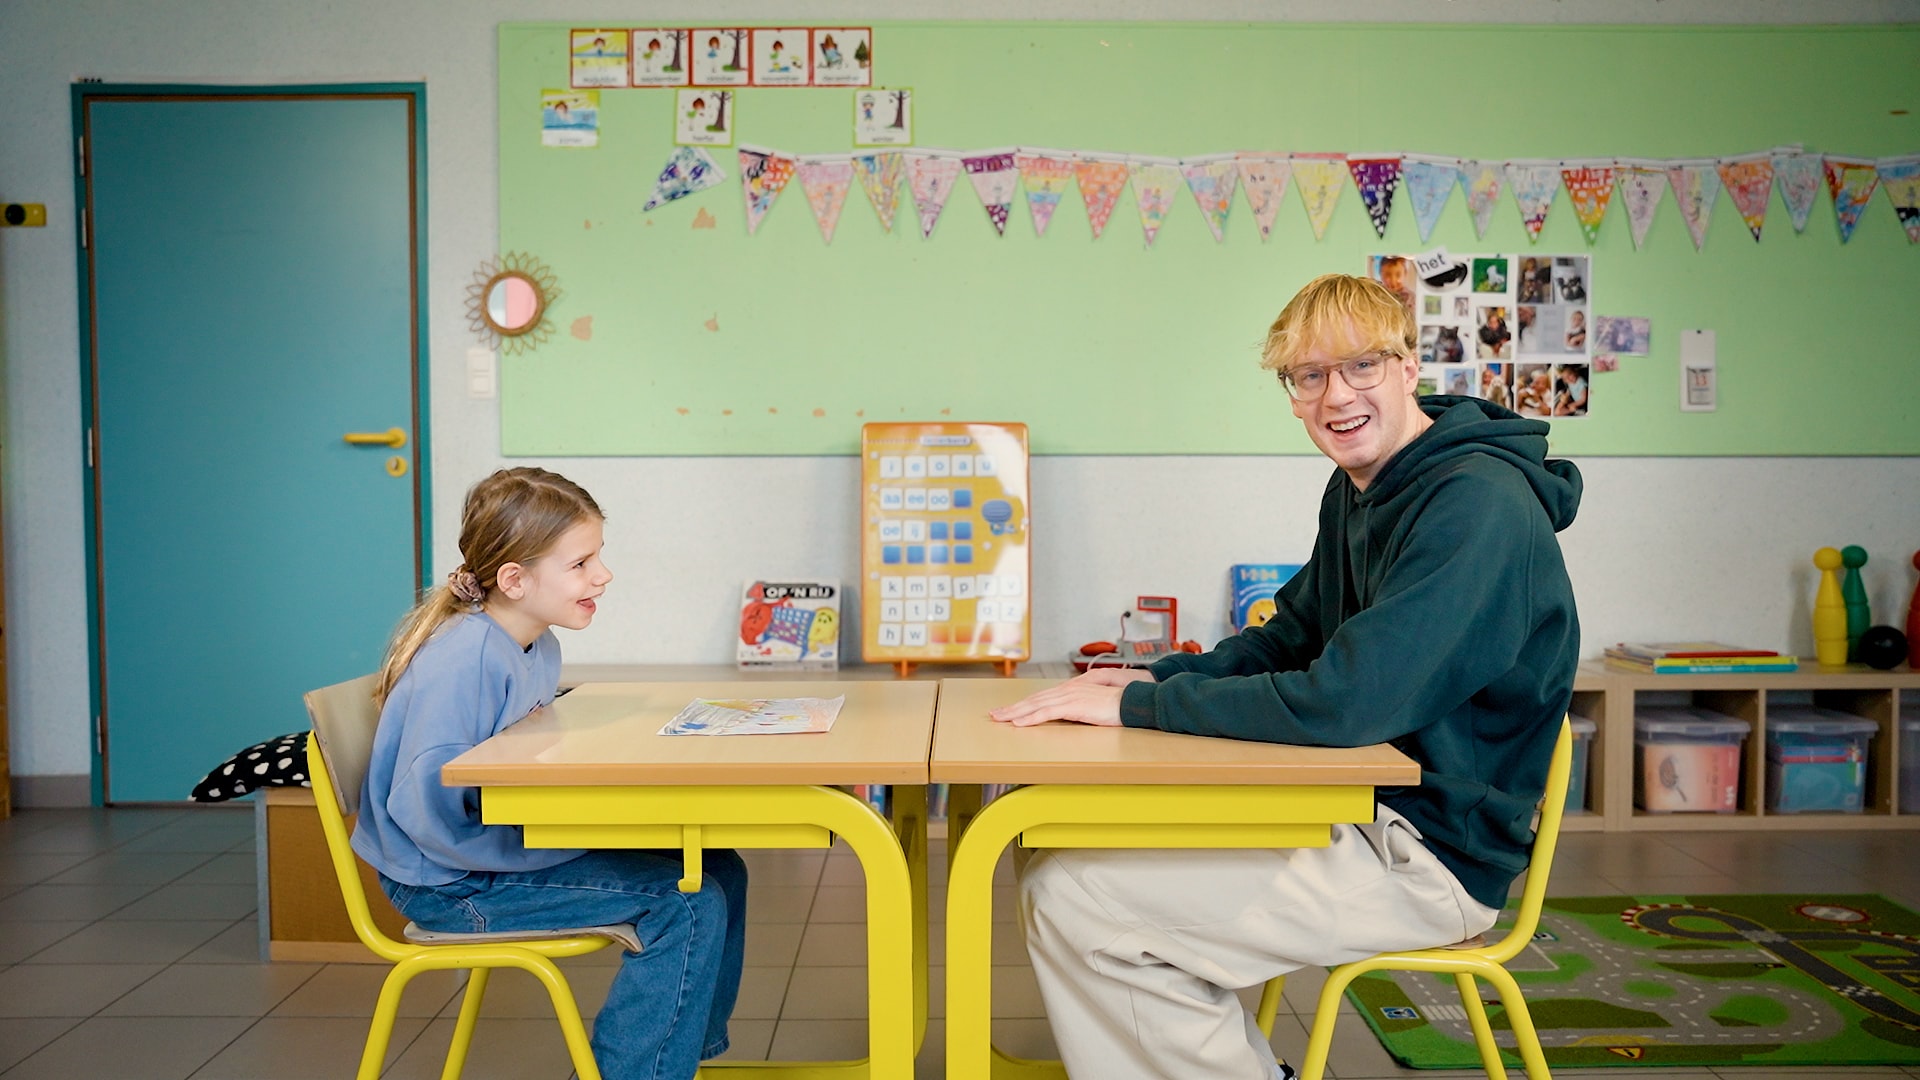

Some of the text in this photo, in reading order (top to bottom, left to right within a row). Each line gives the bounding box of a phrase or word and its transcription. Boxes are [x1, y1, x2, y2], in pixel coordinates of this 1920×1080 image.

[1417, 252, 1446, 273] het
[911, 462, 921, 472] e
[935, 461, 945, 471] o
[958, 461, 968, 471] a
[982, 461, 992, 471] u
[884, 494, 949, 505] aa ee oo
[883, 526, 900, 536] oe
[766, 586, 788, 599] OP
[809, 586, 832, 599] RIJ
[888, 581, 897, 592] k
[910, 583, 923, 592] m
[937, 583, 945, 592] s
[960, 582, 969, 594] p
[888, 606, 897, 616] n
[914, 605, 920, 615] t
[934, 604, 944, 615] b
[886, 629, 922, 640] h w
